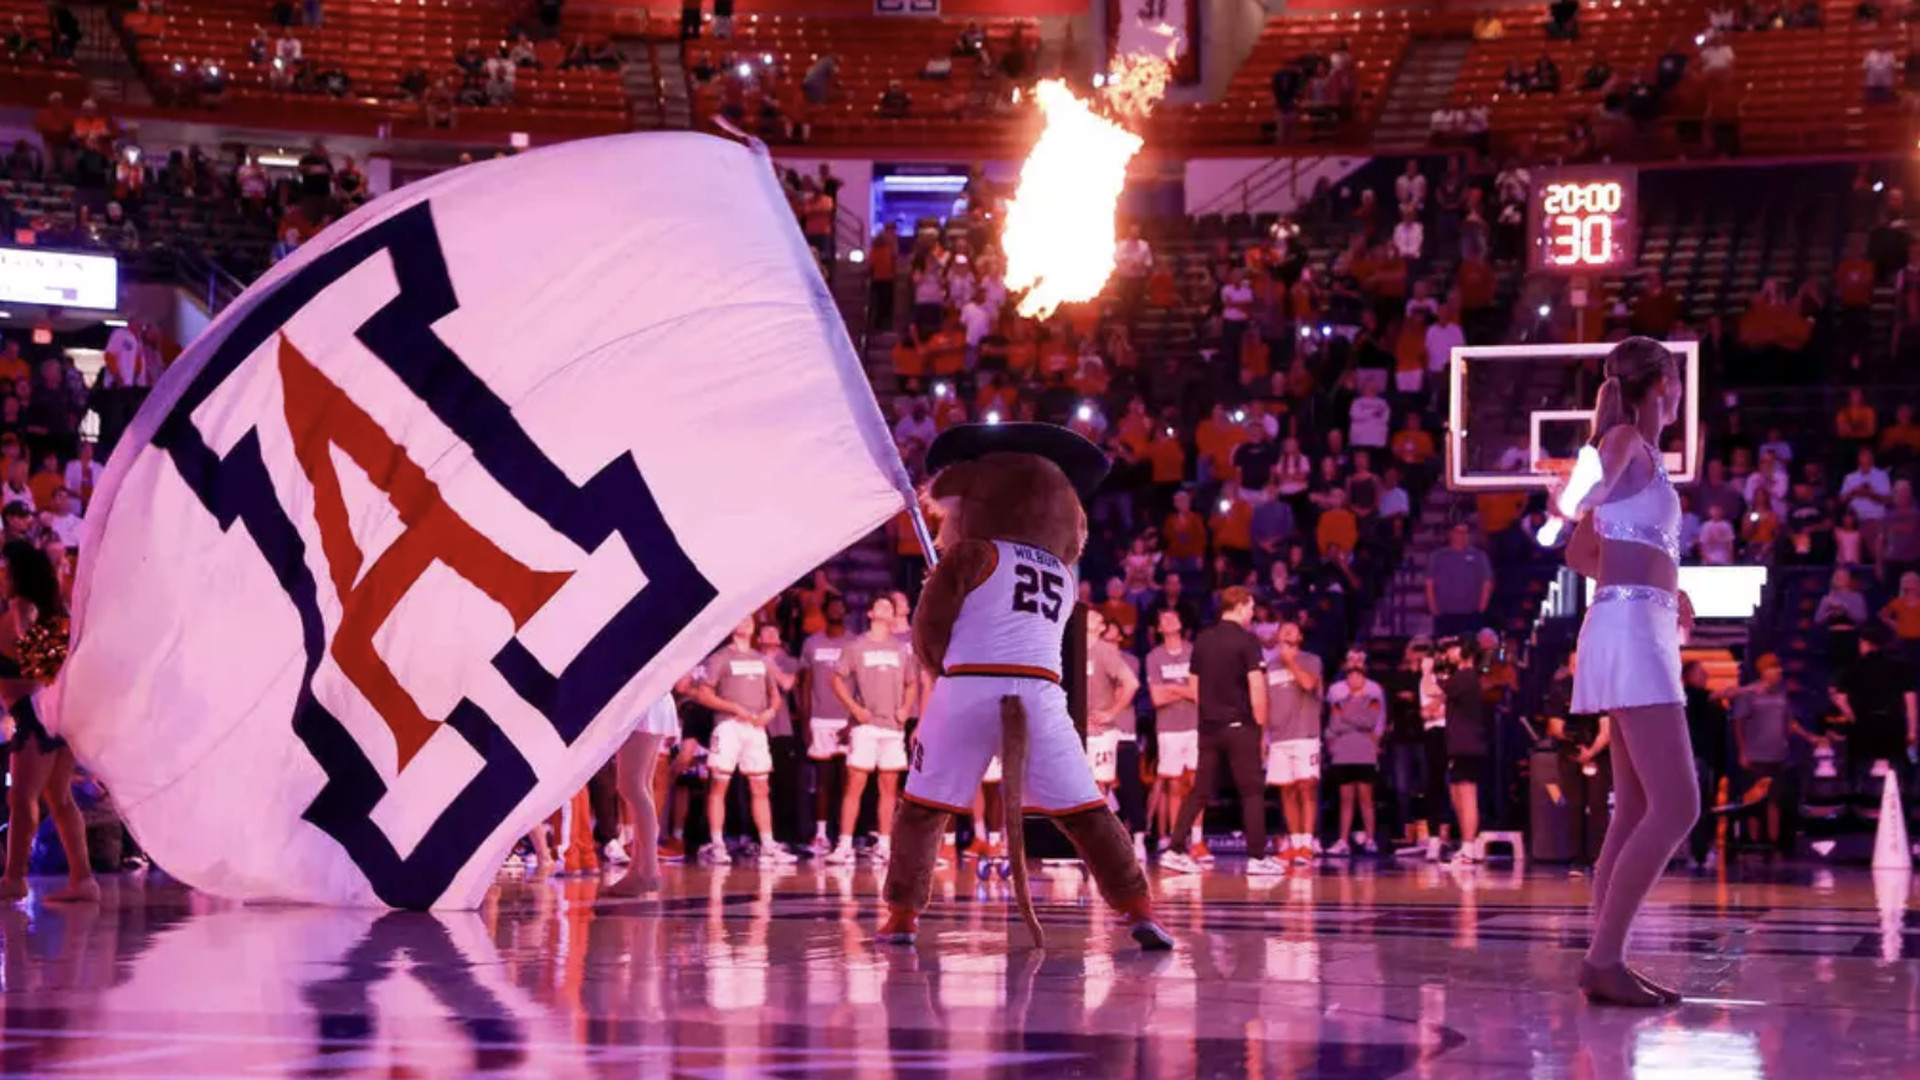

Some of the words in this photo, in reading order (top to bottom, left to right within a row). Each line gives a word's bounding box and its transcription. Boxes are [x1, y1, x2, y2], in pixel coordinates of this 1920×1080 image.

[1544, 182, 1621, 214] 20:00
[1554, 214, 1612, 265] 30
[1013, 545, 1060, 569] WILBUR
[1012, 564, 1064, 623] 25
